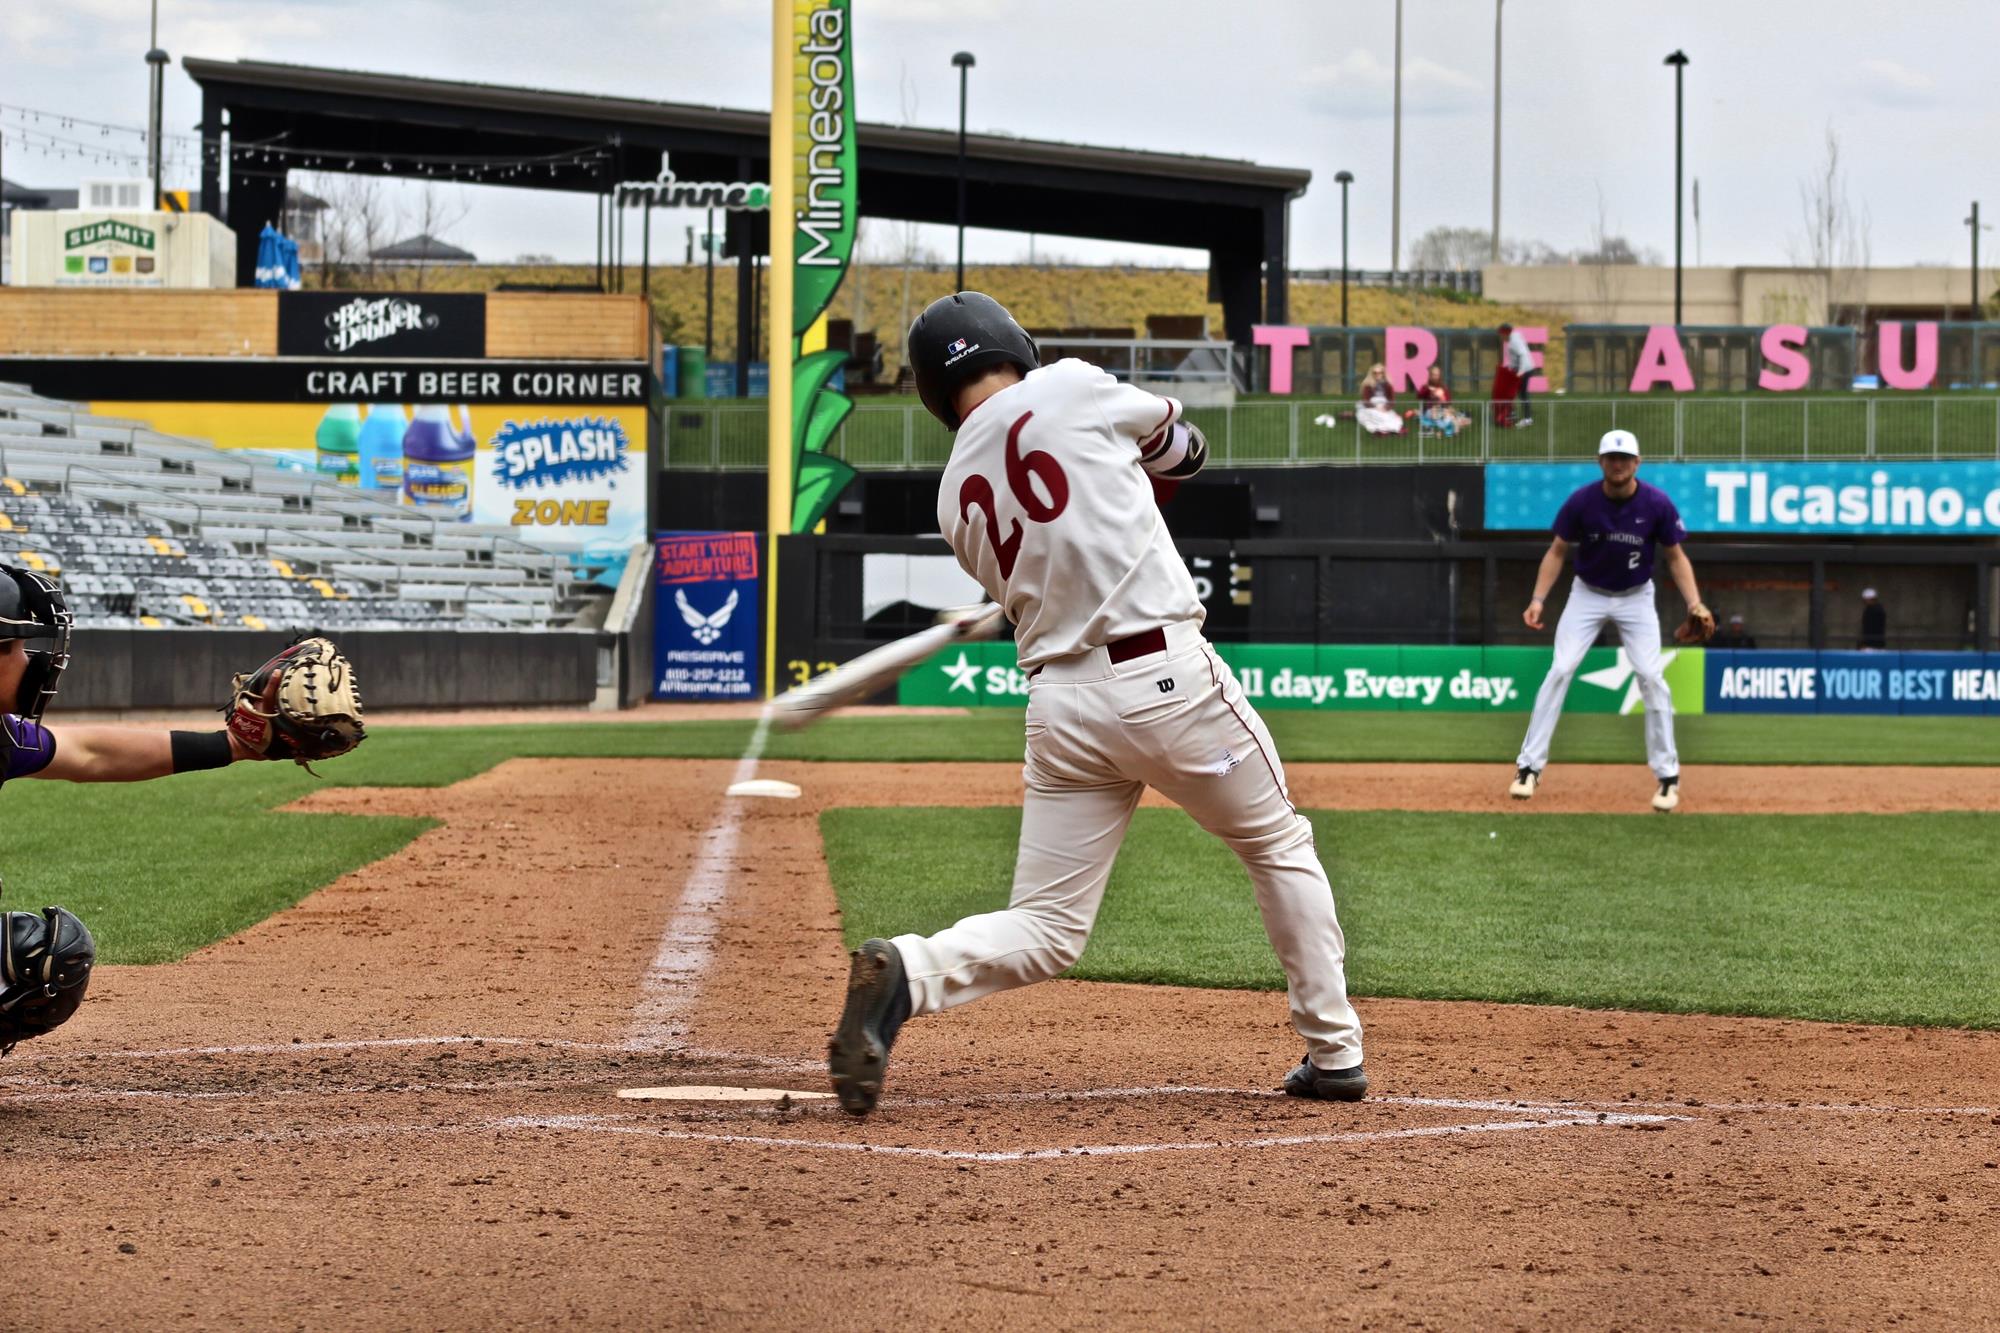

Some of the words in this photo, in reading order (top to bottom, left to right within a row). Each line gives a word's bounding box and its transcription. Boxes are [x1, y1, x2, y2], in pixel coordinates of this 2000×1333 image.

[797, 8, 843, 266] Minnesota
[69, 223, 151, 246] SUMMIT
[306, 371, 407, 395] CRAFT
[418, 372, 500, 396] BEER
[512, 373, 642, 397] CORNER
[504, 429, 617, 477] SPLASH
[959, 410, 1070, 582] 26
[511, 500, 609, 525] ZONE
[660, 543, 705, 559] START
[710, 538, 751, 554] YOUR
[1628, 551, 1641, 569] 2
[663, 555, 751, 576] ADVENTURE
[667, 651, 744, 663] RESERVE
[1270, 669, 1339, 704] day.
[1344, 668, 1443, 705] Every
[1450, 669, 1518, 705] day.
[1719, 667, 1817, 699] ACHIEVE
[1821, 668, 1883, 700] YOUR
[1888, 669, 1947, 700] BEST
